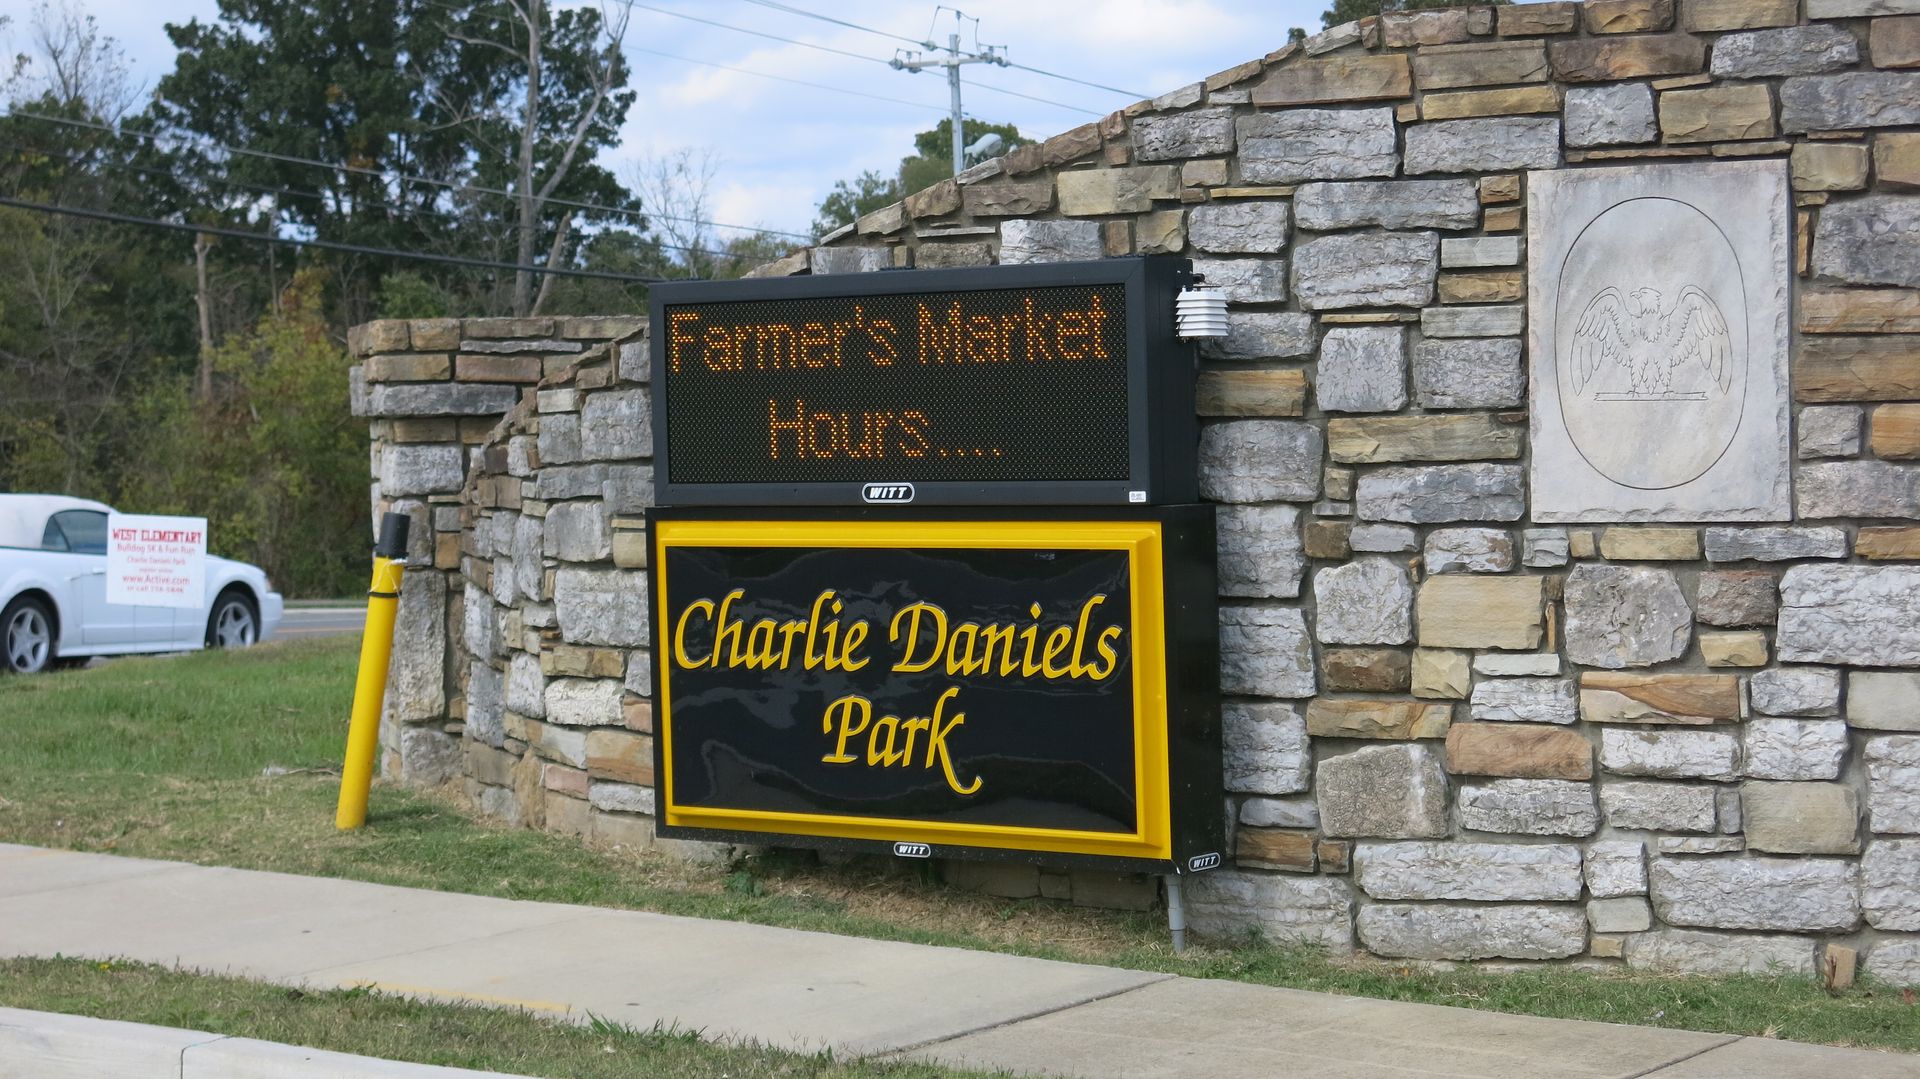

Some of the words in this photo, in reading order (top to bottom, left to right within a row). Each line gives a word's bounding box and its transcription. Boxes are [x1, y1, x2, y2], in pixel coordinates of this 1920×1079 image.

[669, 304, 898, 374] Farmer's
[917, 294, 1109, 365] Market
[868, 486, 909, 500] WITT
[112, 528, 137, 541] WEST
[141, 529, 202, 544] ELEMENTARY
[674, 587, 871, 673] Charlie
[887, 592, 1123, 682] Daniels
[821, 685, 984, 796] Park
[898, 844, 926, 856] WITT
[1192, 855, 1217, 869] WITT
